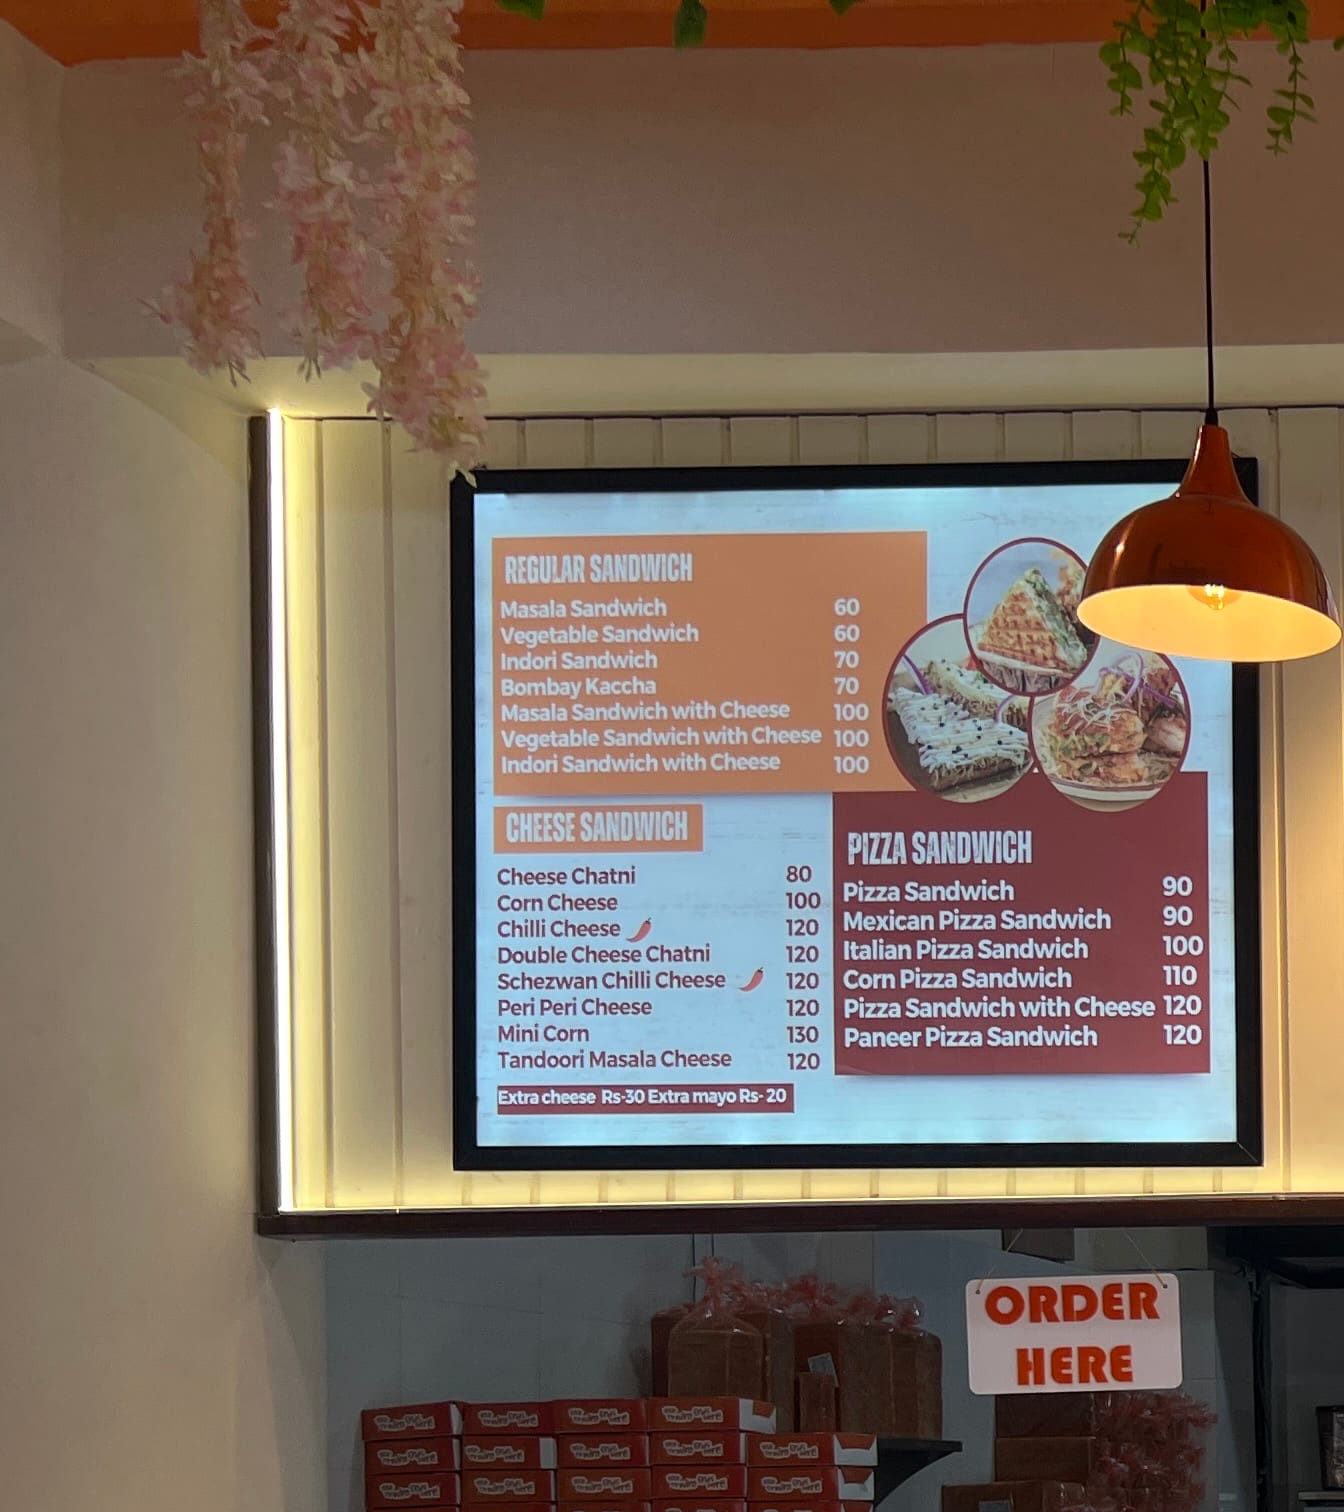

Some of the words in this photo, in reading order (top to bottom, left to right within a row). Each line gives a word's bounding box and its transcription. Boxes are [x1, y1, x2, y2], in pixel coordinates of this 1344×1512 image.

[505, 554, 585, 584] REGULAR
[589, 552, 693, 583] SANDWICH
[500, 599, 567, 619] Masala
[570, 597, 667, 618] Sandwich
[834, 597, 860, 616] 60
[500, 651, 557, 671] Indori
[561, 649, 658, 670] Sandwich
[834, 650, 860, 669] 70
[501, 677, 582, 700] Bombay
[585, 675, 657, 695] Kaccha
[833, 676, 860, 695] 70
[501, 728, 600, 753] Vegetable
[603, 726, 700, 747] Sandwich
[703, 726, 748, 745] with
[751, 725, 823, 745] Cheese
[833, 729, 870, 748] 100
[506, 812, 576, 843] CHEESE
[579, 810, 688, 842] SANDWICH
[847, 831, 907, 865] PIZZA
[911, 830, 1032, 865] SANDWICH
[497, 867, 568, 886] Cheese
[571, 866, 636, 885] Chatni
[786, 865, 812, 883] 80
[843, 882, 901, 902] Pizza
[904, 879, 1015, 902] Sandwich
[1162, 875, 1193, 897] 90
[497, 894, 544, 912] Corn
[547, 893, 618, 912] Cheese
[785, 891, 821, 910] 100
[843, 911, 935, 932] Mexican
[939, 910, 997, 931] Pizza
[1000, 908, 1112, 930] Sandwich
[1162, 905, 1193, 926] 90
[498, 1025, 539, 1043] Mini
[543, 1024, 590, 1042] Corn
[786, 1025, 819, 1044] 130
[497, 1050, 585, 1069] Tandoori
[589, 1049, 657, 1068] Masala
[660, 1049, 732, 1068] Cheese
[786, 1052, 821, 1071] 120
[498, 1090, 539, 1105] Extra
[542, 1089, 597, 1105] cheese
[648, 1089, 689, 1104] Extra
[693, 1091, 736, 1106] mayo
[767, 1088, 786, 1103] 20
[984, 1283, 1160, 1326] ORDER
[1015, 1343, 1134, 1387] HERE
